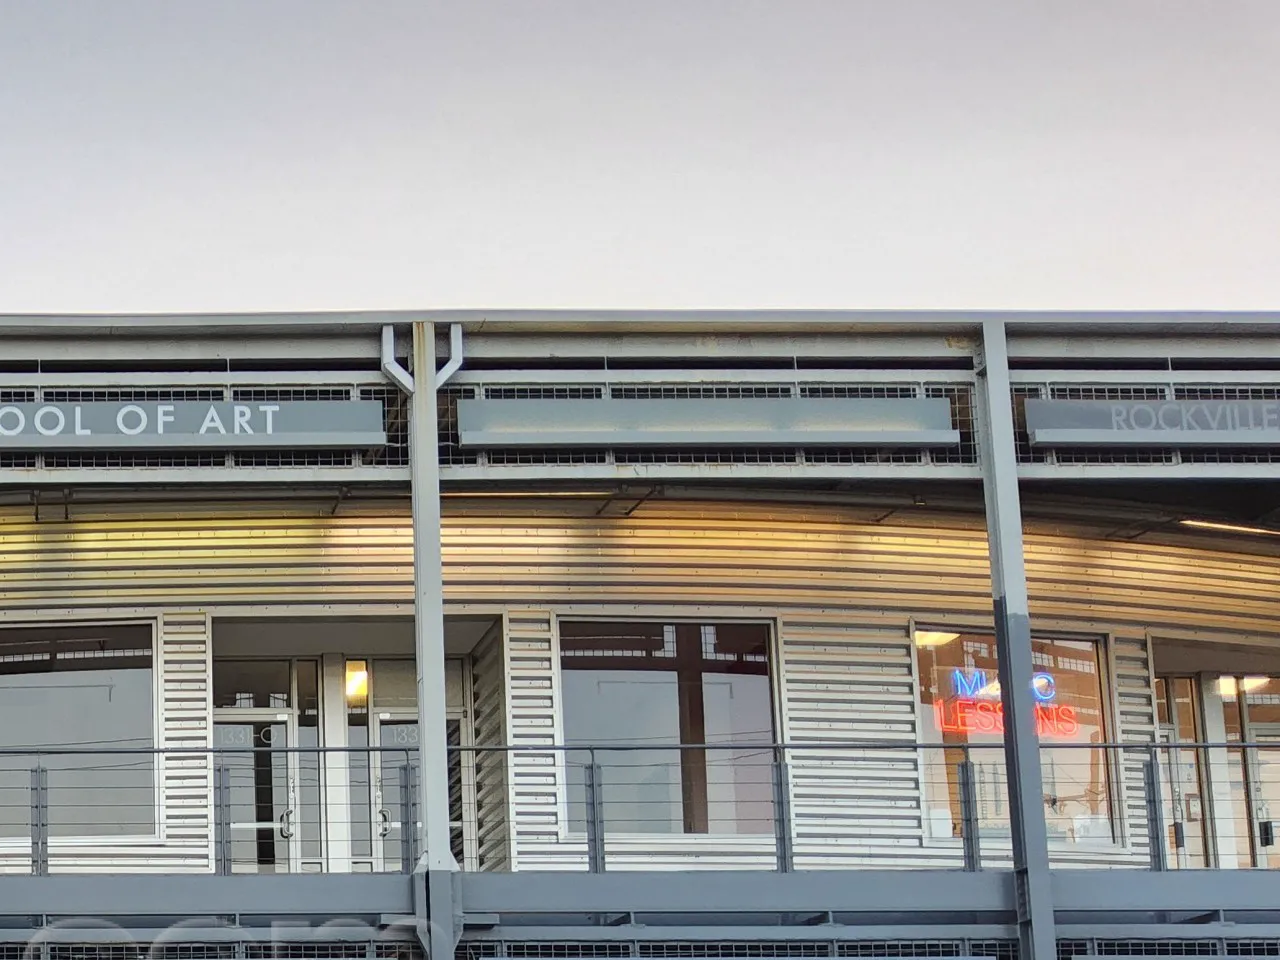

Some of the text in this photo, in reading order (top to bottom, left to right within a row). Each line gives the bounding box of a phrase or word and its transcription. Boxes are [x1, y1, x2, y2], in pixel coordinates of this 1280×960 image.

[116, 404, 175, 436] OF
[198, 404, 281, 435] ART
[1111, 404, 1279, 431] ROCKVILLE
